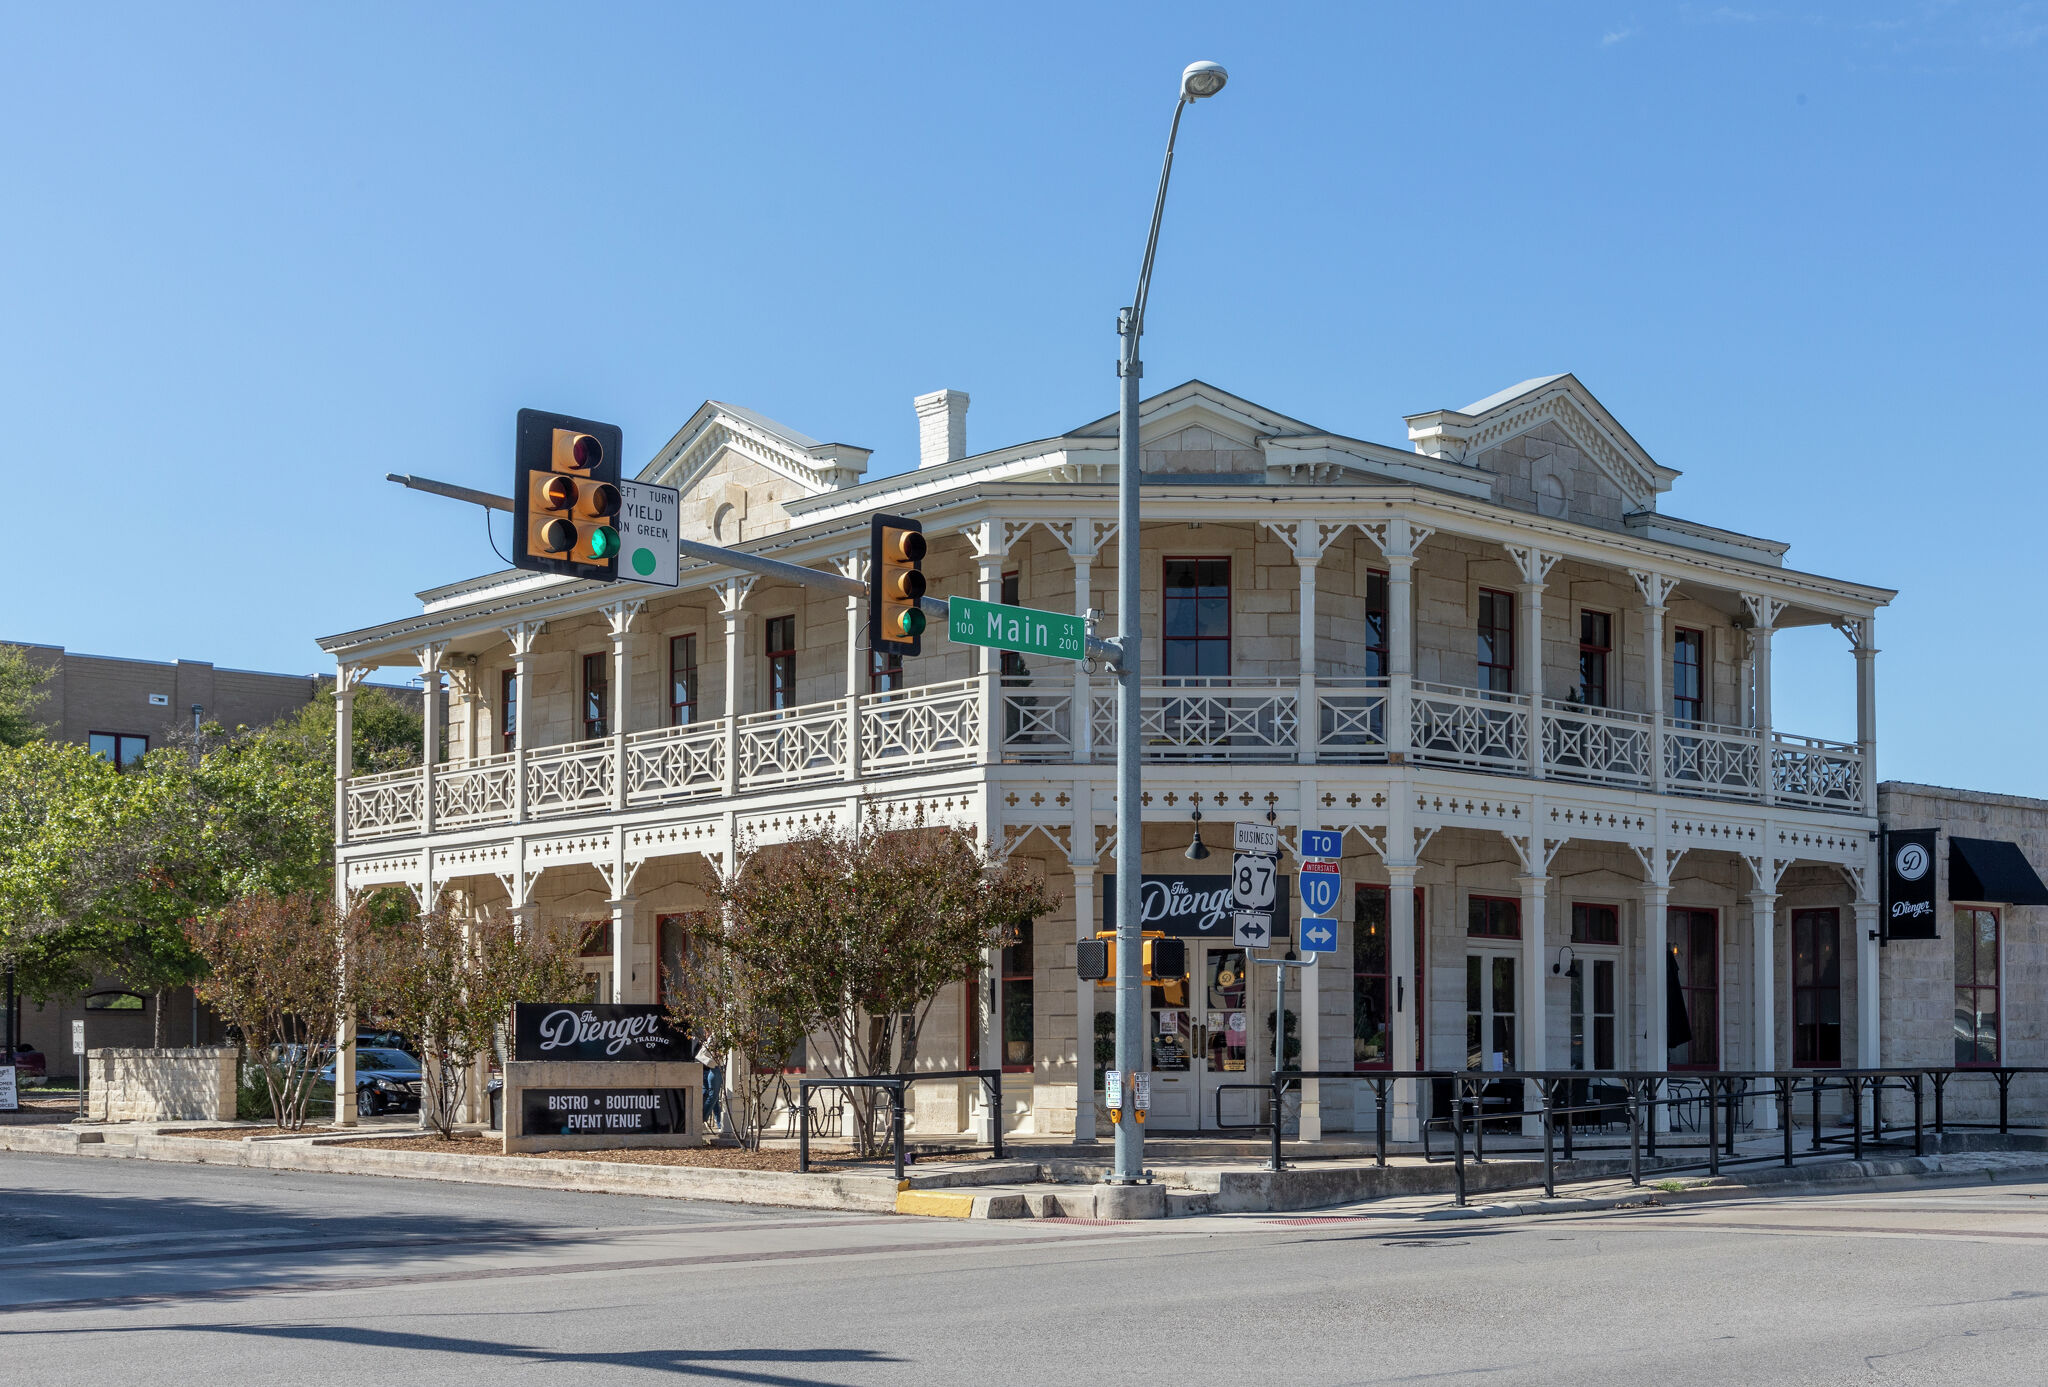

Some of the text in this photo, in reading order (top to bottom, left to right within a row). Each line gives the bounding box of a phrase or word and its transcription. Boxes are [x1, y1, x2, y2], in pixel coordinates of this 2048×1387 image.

[621, 486, 674, 505] EFT TURN
[627, 503, 663, 522] YIELD
[637, 524, 668, 539] GREEN
[956, 622, 974, 635] 100
[964, 608, 1074, 647] N Main St
[1059, 638, 1079, 651] 200
[1239, 830, 1274, 846] BUSINESS
[1312, 836, 1332, 852] TO
[1306, 863, 1335, 873] INTERSTATE
[1171, 881, 1189, 895] The
[1240, 866, 1271, 896] 87
[1309, 880, 1330, 906] 10
[580, 1010, 598, 1023] The
[540, 1009, 659, 1056] Dienger
[633, 1035, 670, 1045] TRADING
[549, 1095, 660, 1110] BISTRO BOUTIQUE
[567, 1113, 642, 1129] EVENT VENUE
